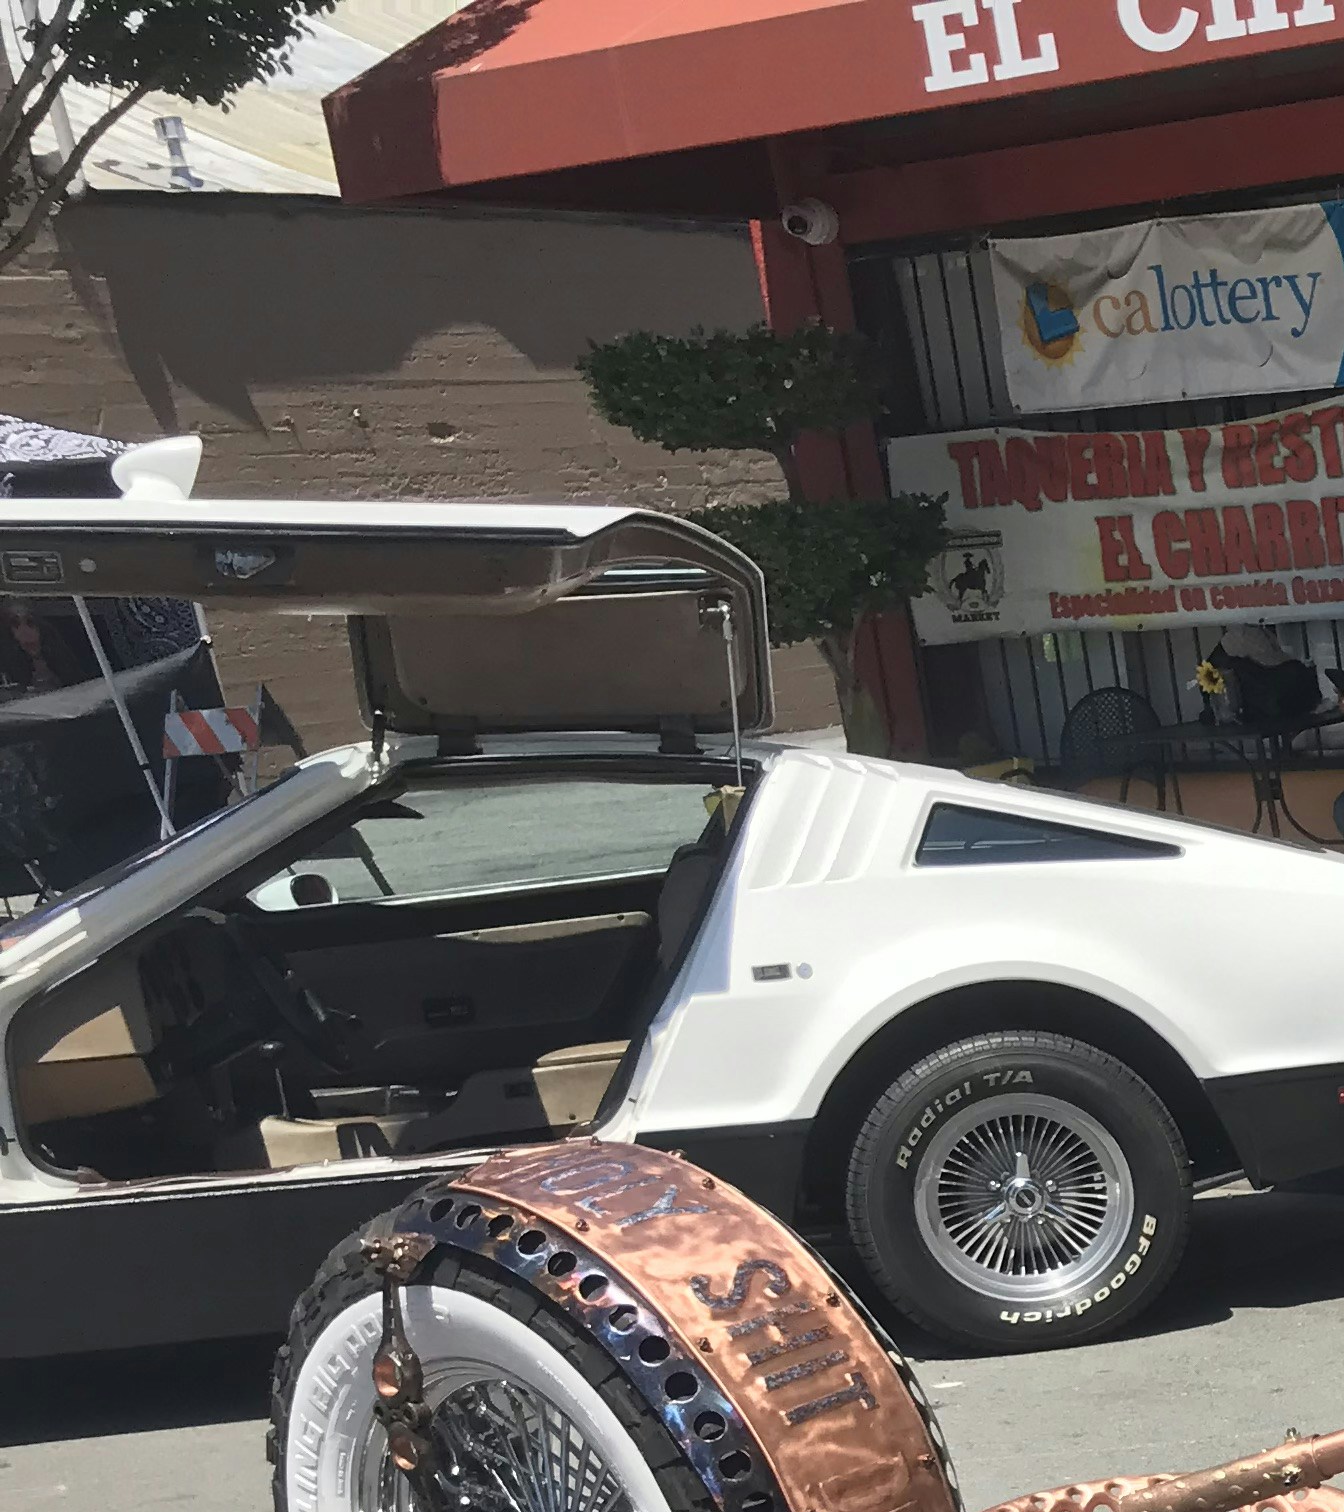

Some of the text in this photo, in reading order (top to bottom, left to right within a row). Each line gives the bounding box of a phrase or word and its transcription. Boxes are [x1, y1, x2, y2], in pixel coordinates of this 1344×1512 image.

[912, 0, 1060, 93] EL
[1092, 263, 1323, 339] calottery
[947, 430, 1177, 513] TAQUERIA
[1179, 428, 1212, 493] Y
[1095, 513, 1153, 582] EL
[951, 611, 1000, 624] MARKET
[1209, 578, 1287, 610] comida
[896, 1069, 1035, 1169] Radial T/A
[999, 1213, 1159, 1324] BFGoodrich
[688, 1258, 882, 1426] SHIT
